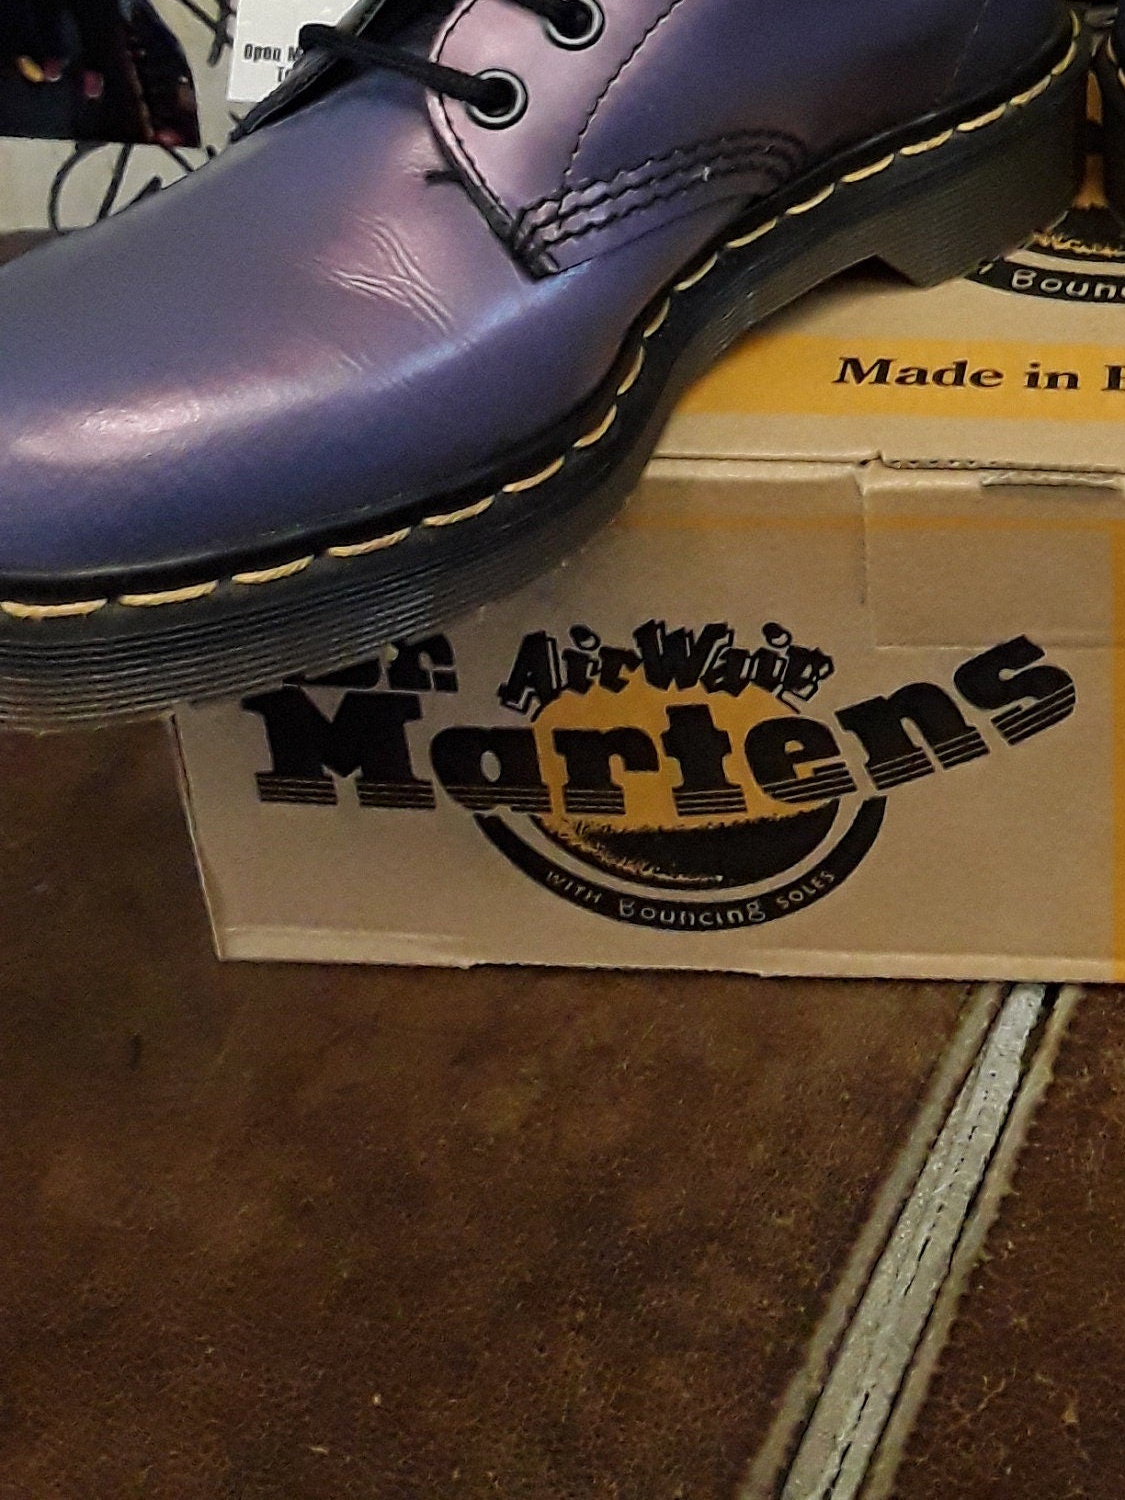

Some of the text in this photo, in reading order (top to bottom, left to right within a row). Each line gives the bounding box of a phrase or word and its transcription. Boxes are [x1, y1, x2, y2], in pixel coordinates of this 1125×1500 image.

[832, 356, 1003, 390] Made
[1024, 362, 1079, 391] in
[241, 634, 1077, 818] Martens
[546, 869, 837, 927] WITH Bouncing SOLES
